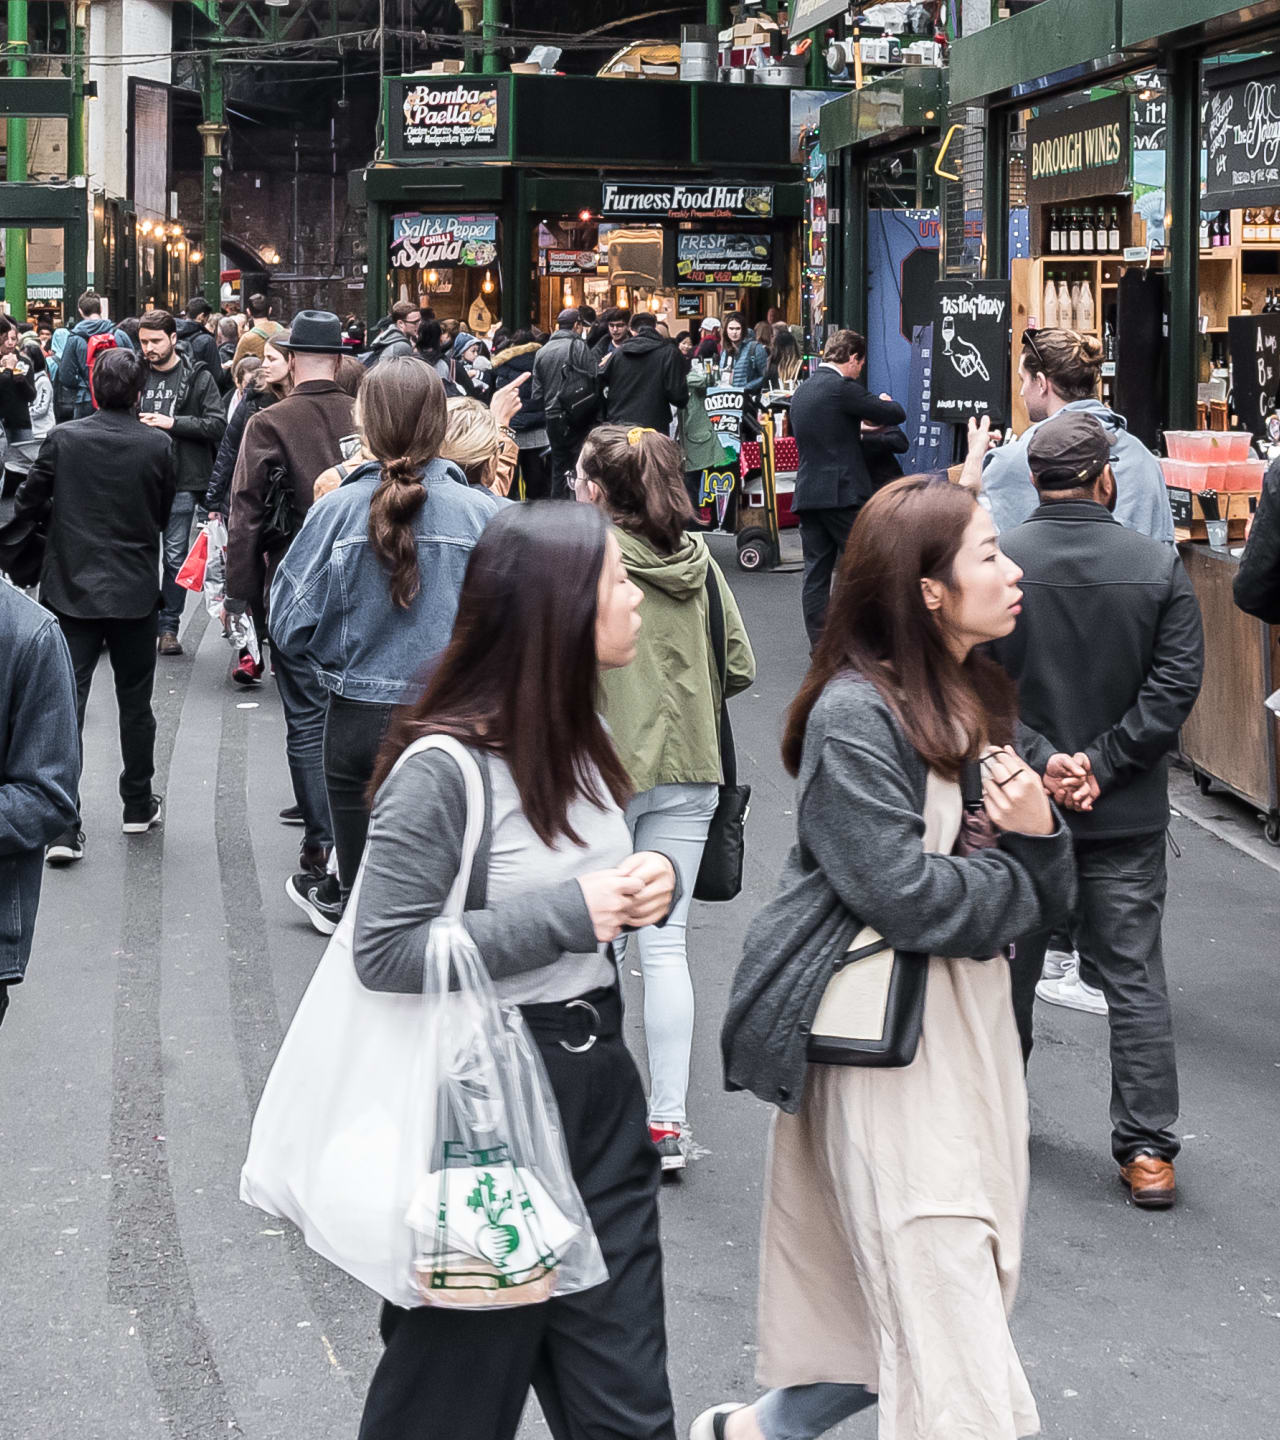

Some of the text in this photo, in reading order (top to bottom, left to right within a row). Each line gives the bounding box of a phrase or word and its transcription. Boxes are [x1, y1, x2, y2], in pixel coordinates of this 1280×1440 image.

[415, 85, 479, 106] Bomba
[414, 104, 470, 124] Paella
[1032, 122, 1120, 177] BOROUGH WINES
[603, 186, 744, 210] Furness Food Hut
[399, 218, 491, 242] Salt & Pepper
[424, 233, 451, 246] CHILLI
[392, 236, 462, 268] Squid
[680, 235, 728, 250] FRESH
[27, 287, 63, 300] BOROUGH
[704, 393, 744, 411] OSECCO
